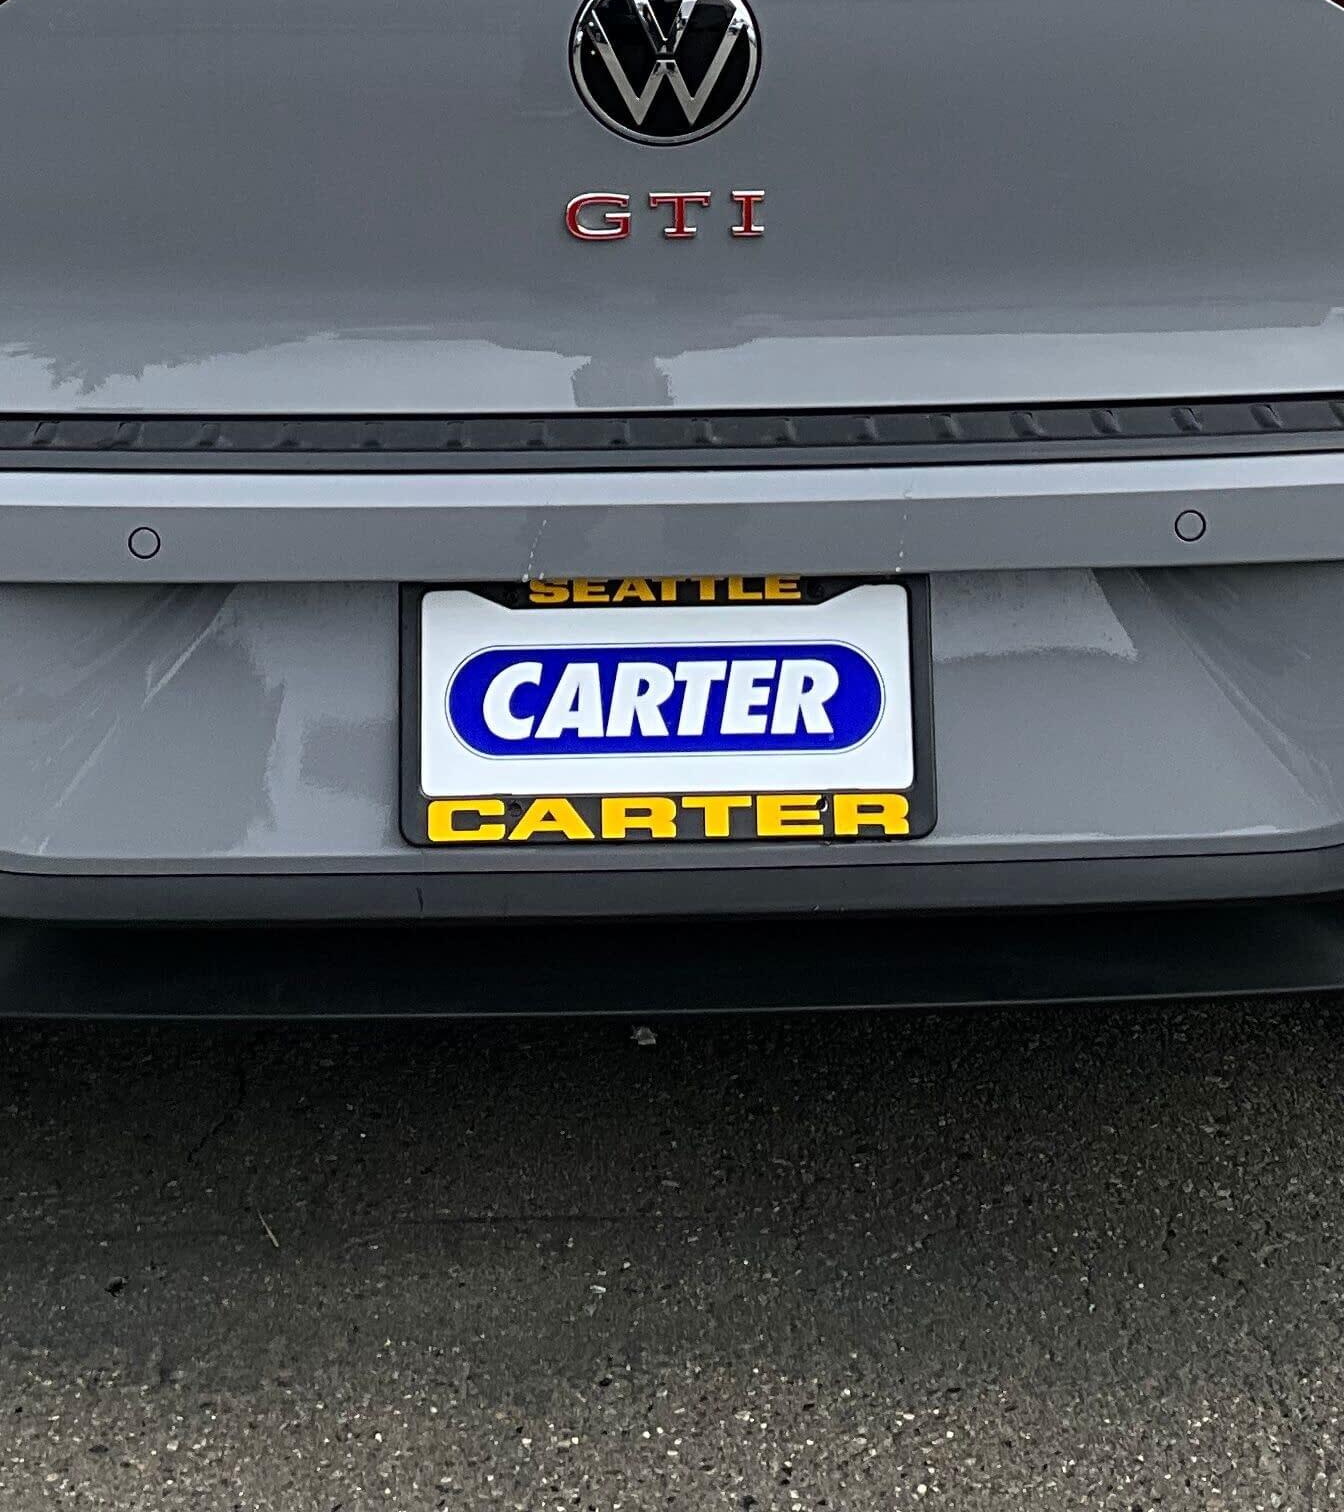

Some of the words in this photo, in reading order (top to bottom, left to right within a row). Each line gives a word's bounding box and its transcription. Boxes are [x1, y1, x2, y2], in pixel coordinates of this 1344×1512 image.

[565, 190, 765, 240] GTI
[529, 574, 803, 604] SEATTLE
[482, 659, 839, 741] CARTER
[427, 793, 910, 843] CARTER
